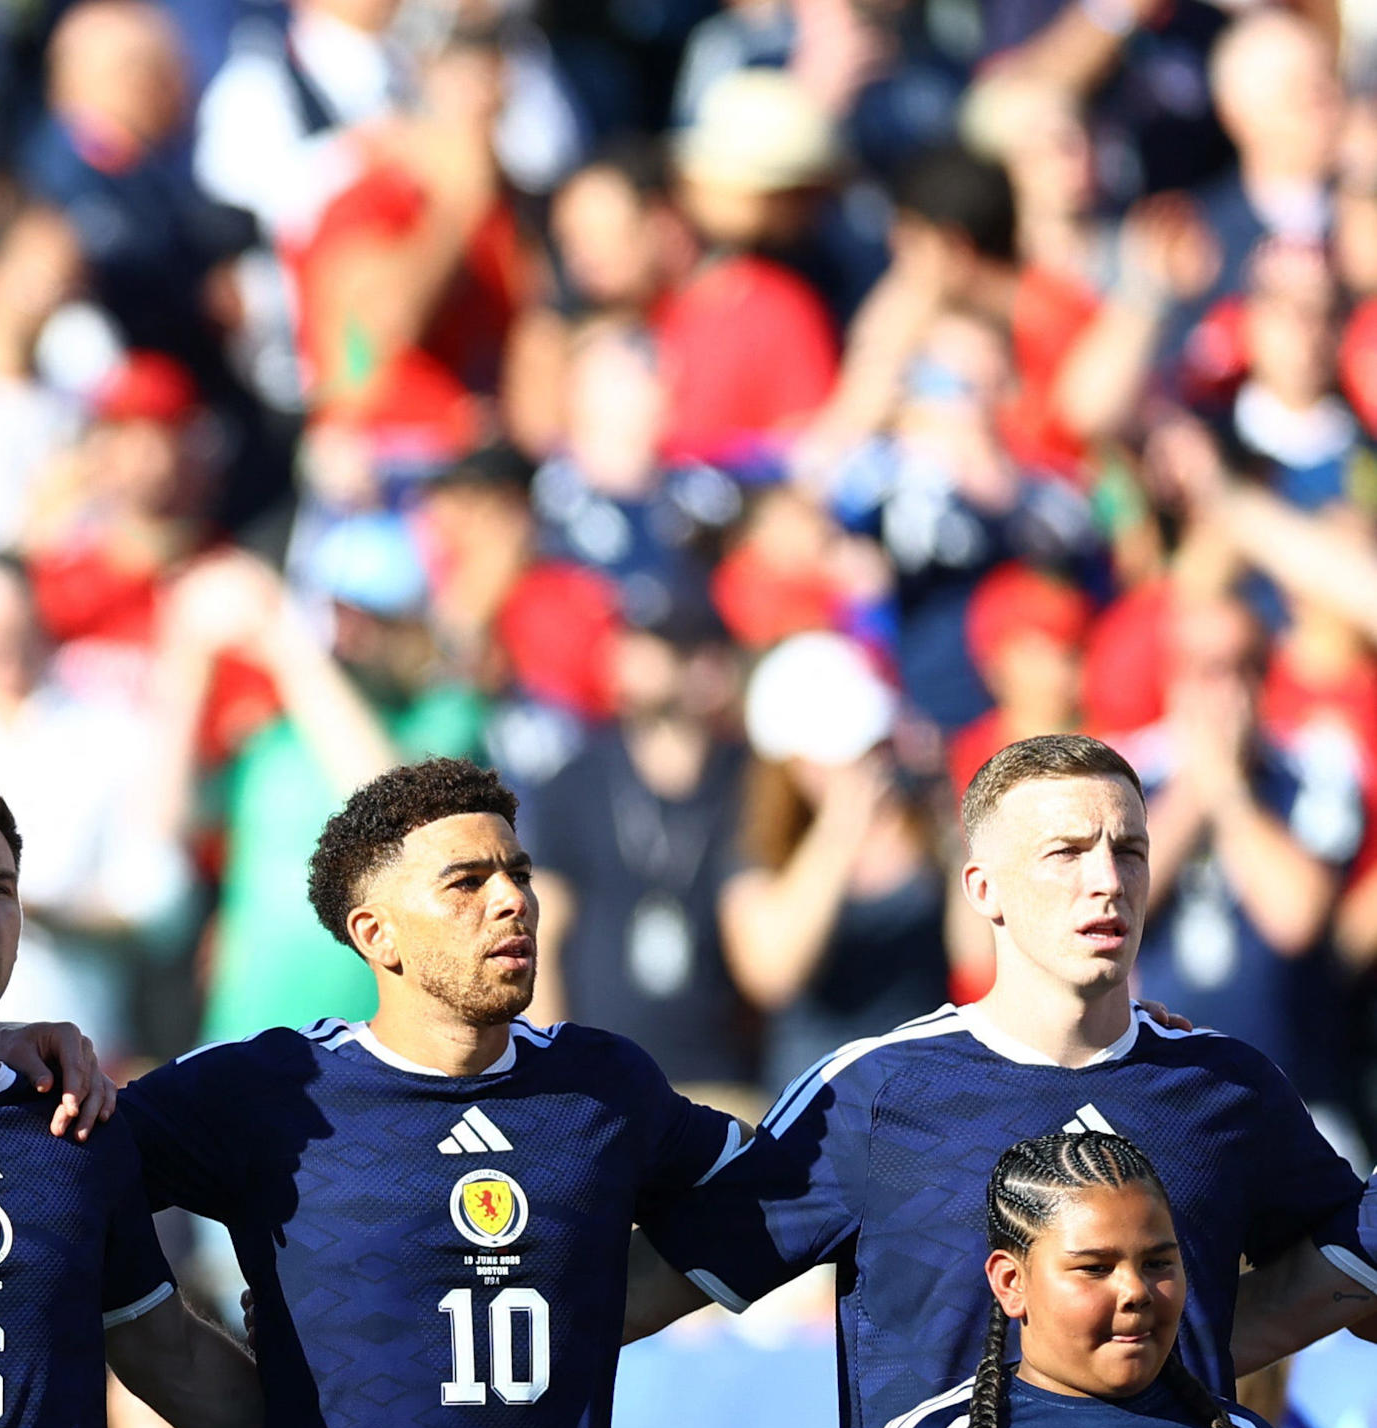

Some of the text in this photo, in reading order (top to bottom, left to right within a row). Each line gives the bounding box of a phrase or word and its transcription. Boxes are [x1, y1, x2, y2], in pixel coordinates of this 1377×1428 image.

[475, 1256, 498, 1265] JUNE
[476, 1266, 509, 1275] BOSTON
[484, 1277, 500, 1285] USA
[438, 1288, 549, 1405] 10
